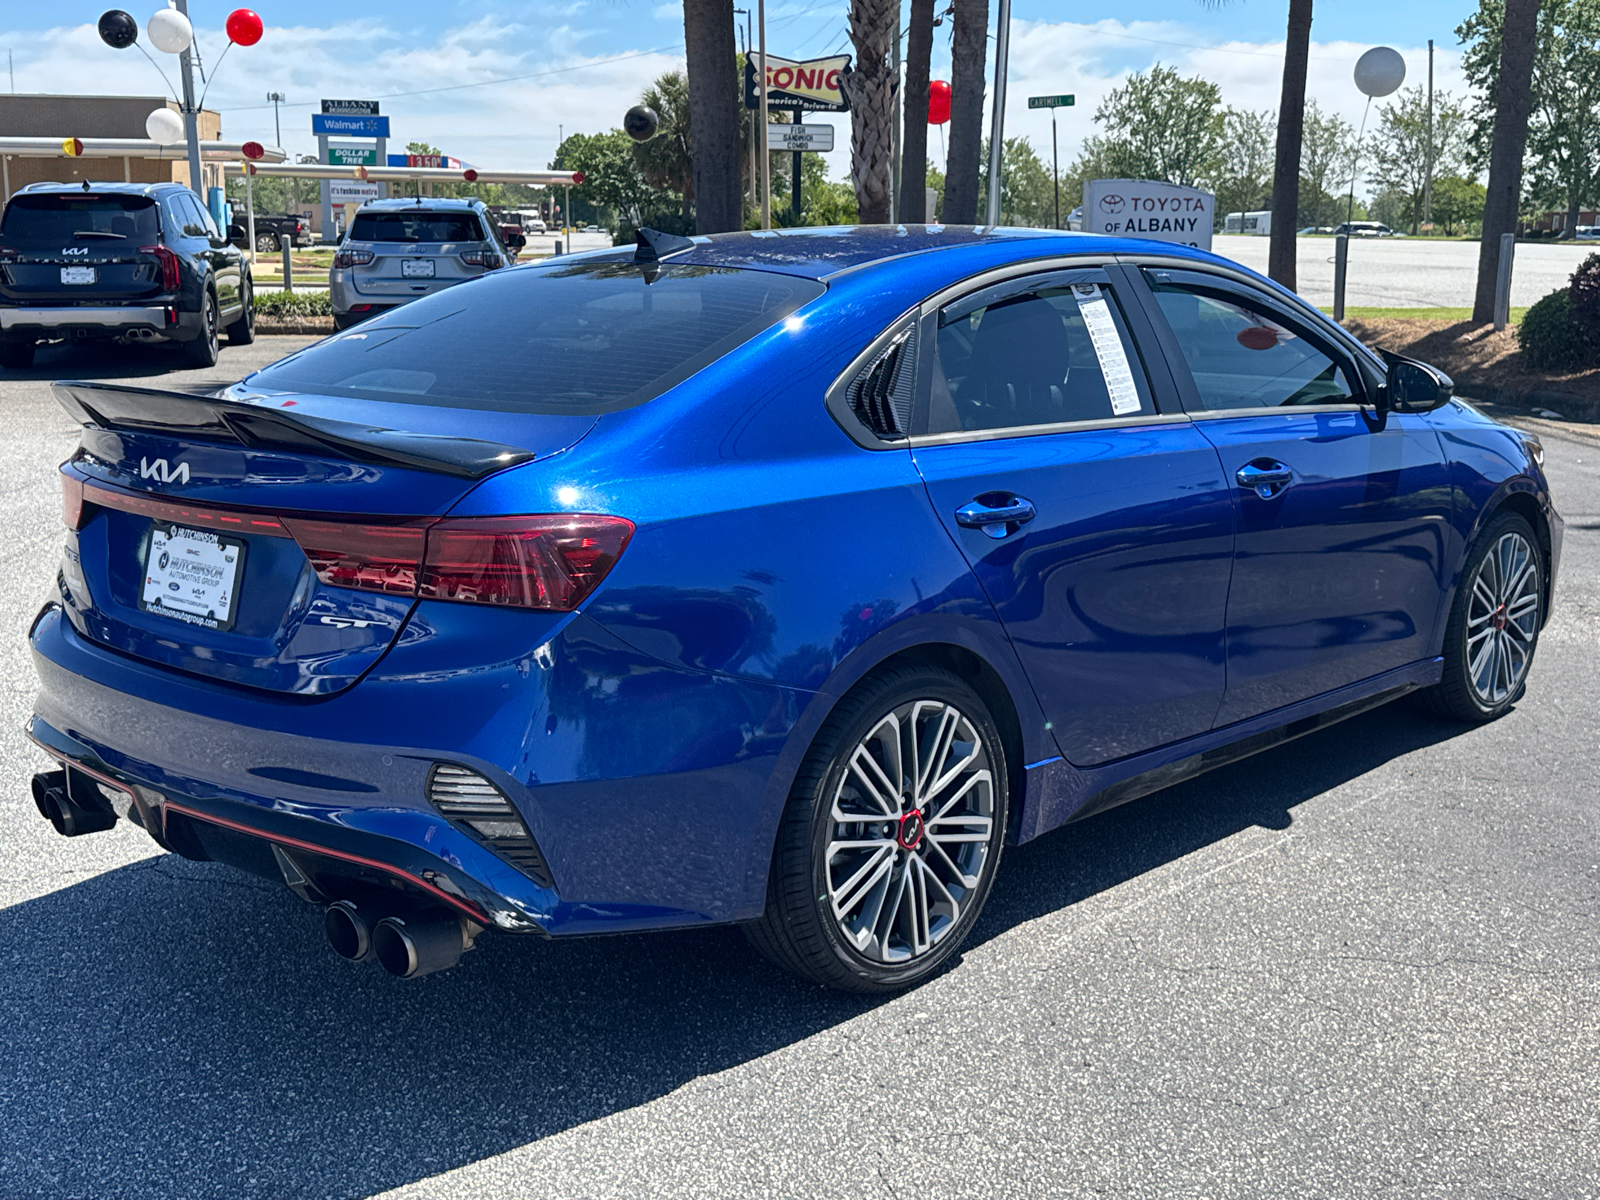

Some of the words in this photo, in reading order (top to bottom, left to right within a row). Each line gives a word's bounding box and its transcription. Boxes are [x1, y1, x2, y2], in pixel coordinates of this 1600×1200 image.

[325, 100, 375, 108] ALBANY
[766, 97, 803, 105] merica's
[324, 119, 365, 130] Walmart
[790, 126, 806, 135] FISH
[783, 134, 814, 142] SANDWICH
[787, 142, 809, 150] COMBO
[335, 149, 370, 157] DOLLAR
[341, 156, 363, 165] TREE
[340, 187, 361, 196] fashion
[1131, 197, 1205, 212] TOYOTA
[1105, 222, 1121, 232] OF
[1124, 217, 1198, 232] ALBANY
[62, 247, 88, 255] KIA
[140, 456, 190, 485] KIA
[177, 527, 219, 544] HUTCHINSON
[169, 557, 225, 579] HUTCHINSON
[168, 570, 202, 584] AUTOMOTIVE
[201, 577, 221, 588] GROUP
[146, 602, 218, 629] Hutchinsonautogroup.com
